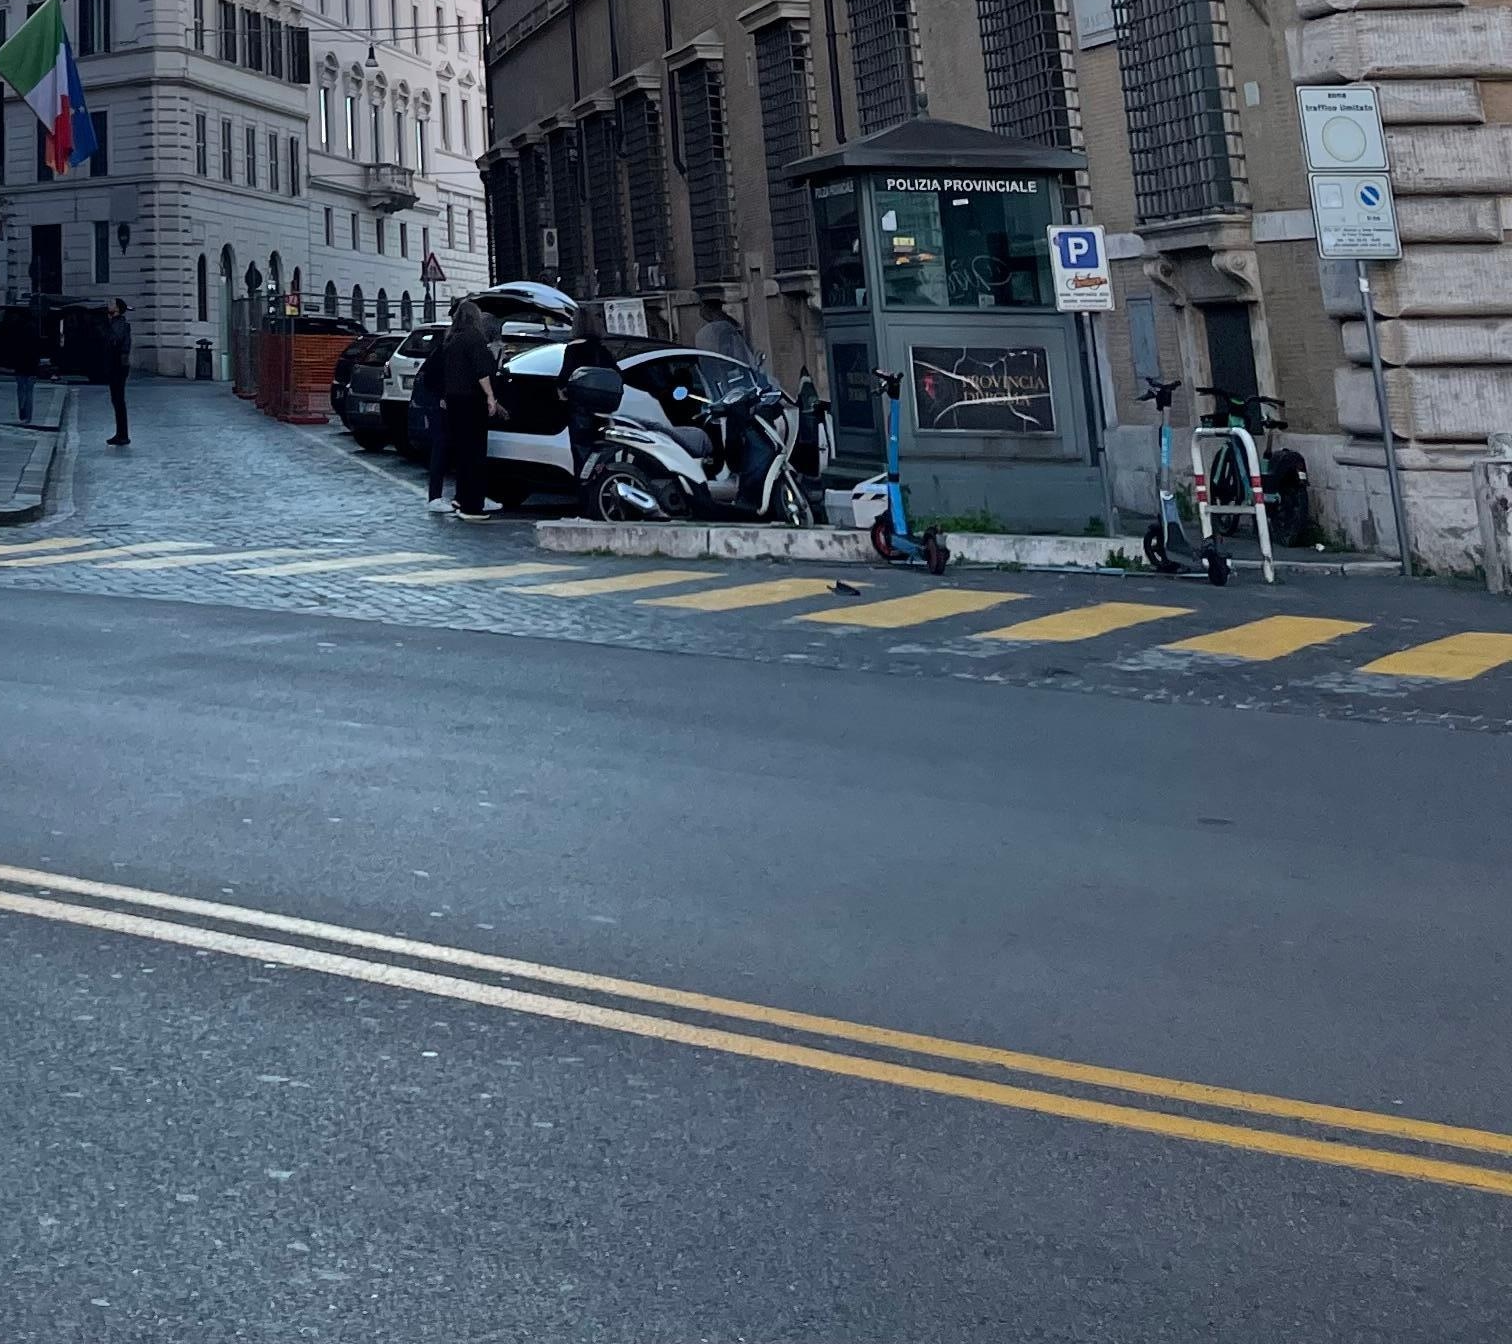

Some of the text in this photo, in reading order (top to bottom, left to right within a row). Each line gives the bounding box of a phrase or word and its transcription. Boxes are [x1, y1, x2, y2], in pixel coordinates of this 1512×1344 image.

[886, 178, 1037, 194] POLIZIA PROVINCIALE
[1067, 237, 1089, 265] P
[963, 375, 1045, 389] PROVINCIA
